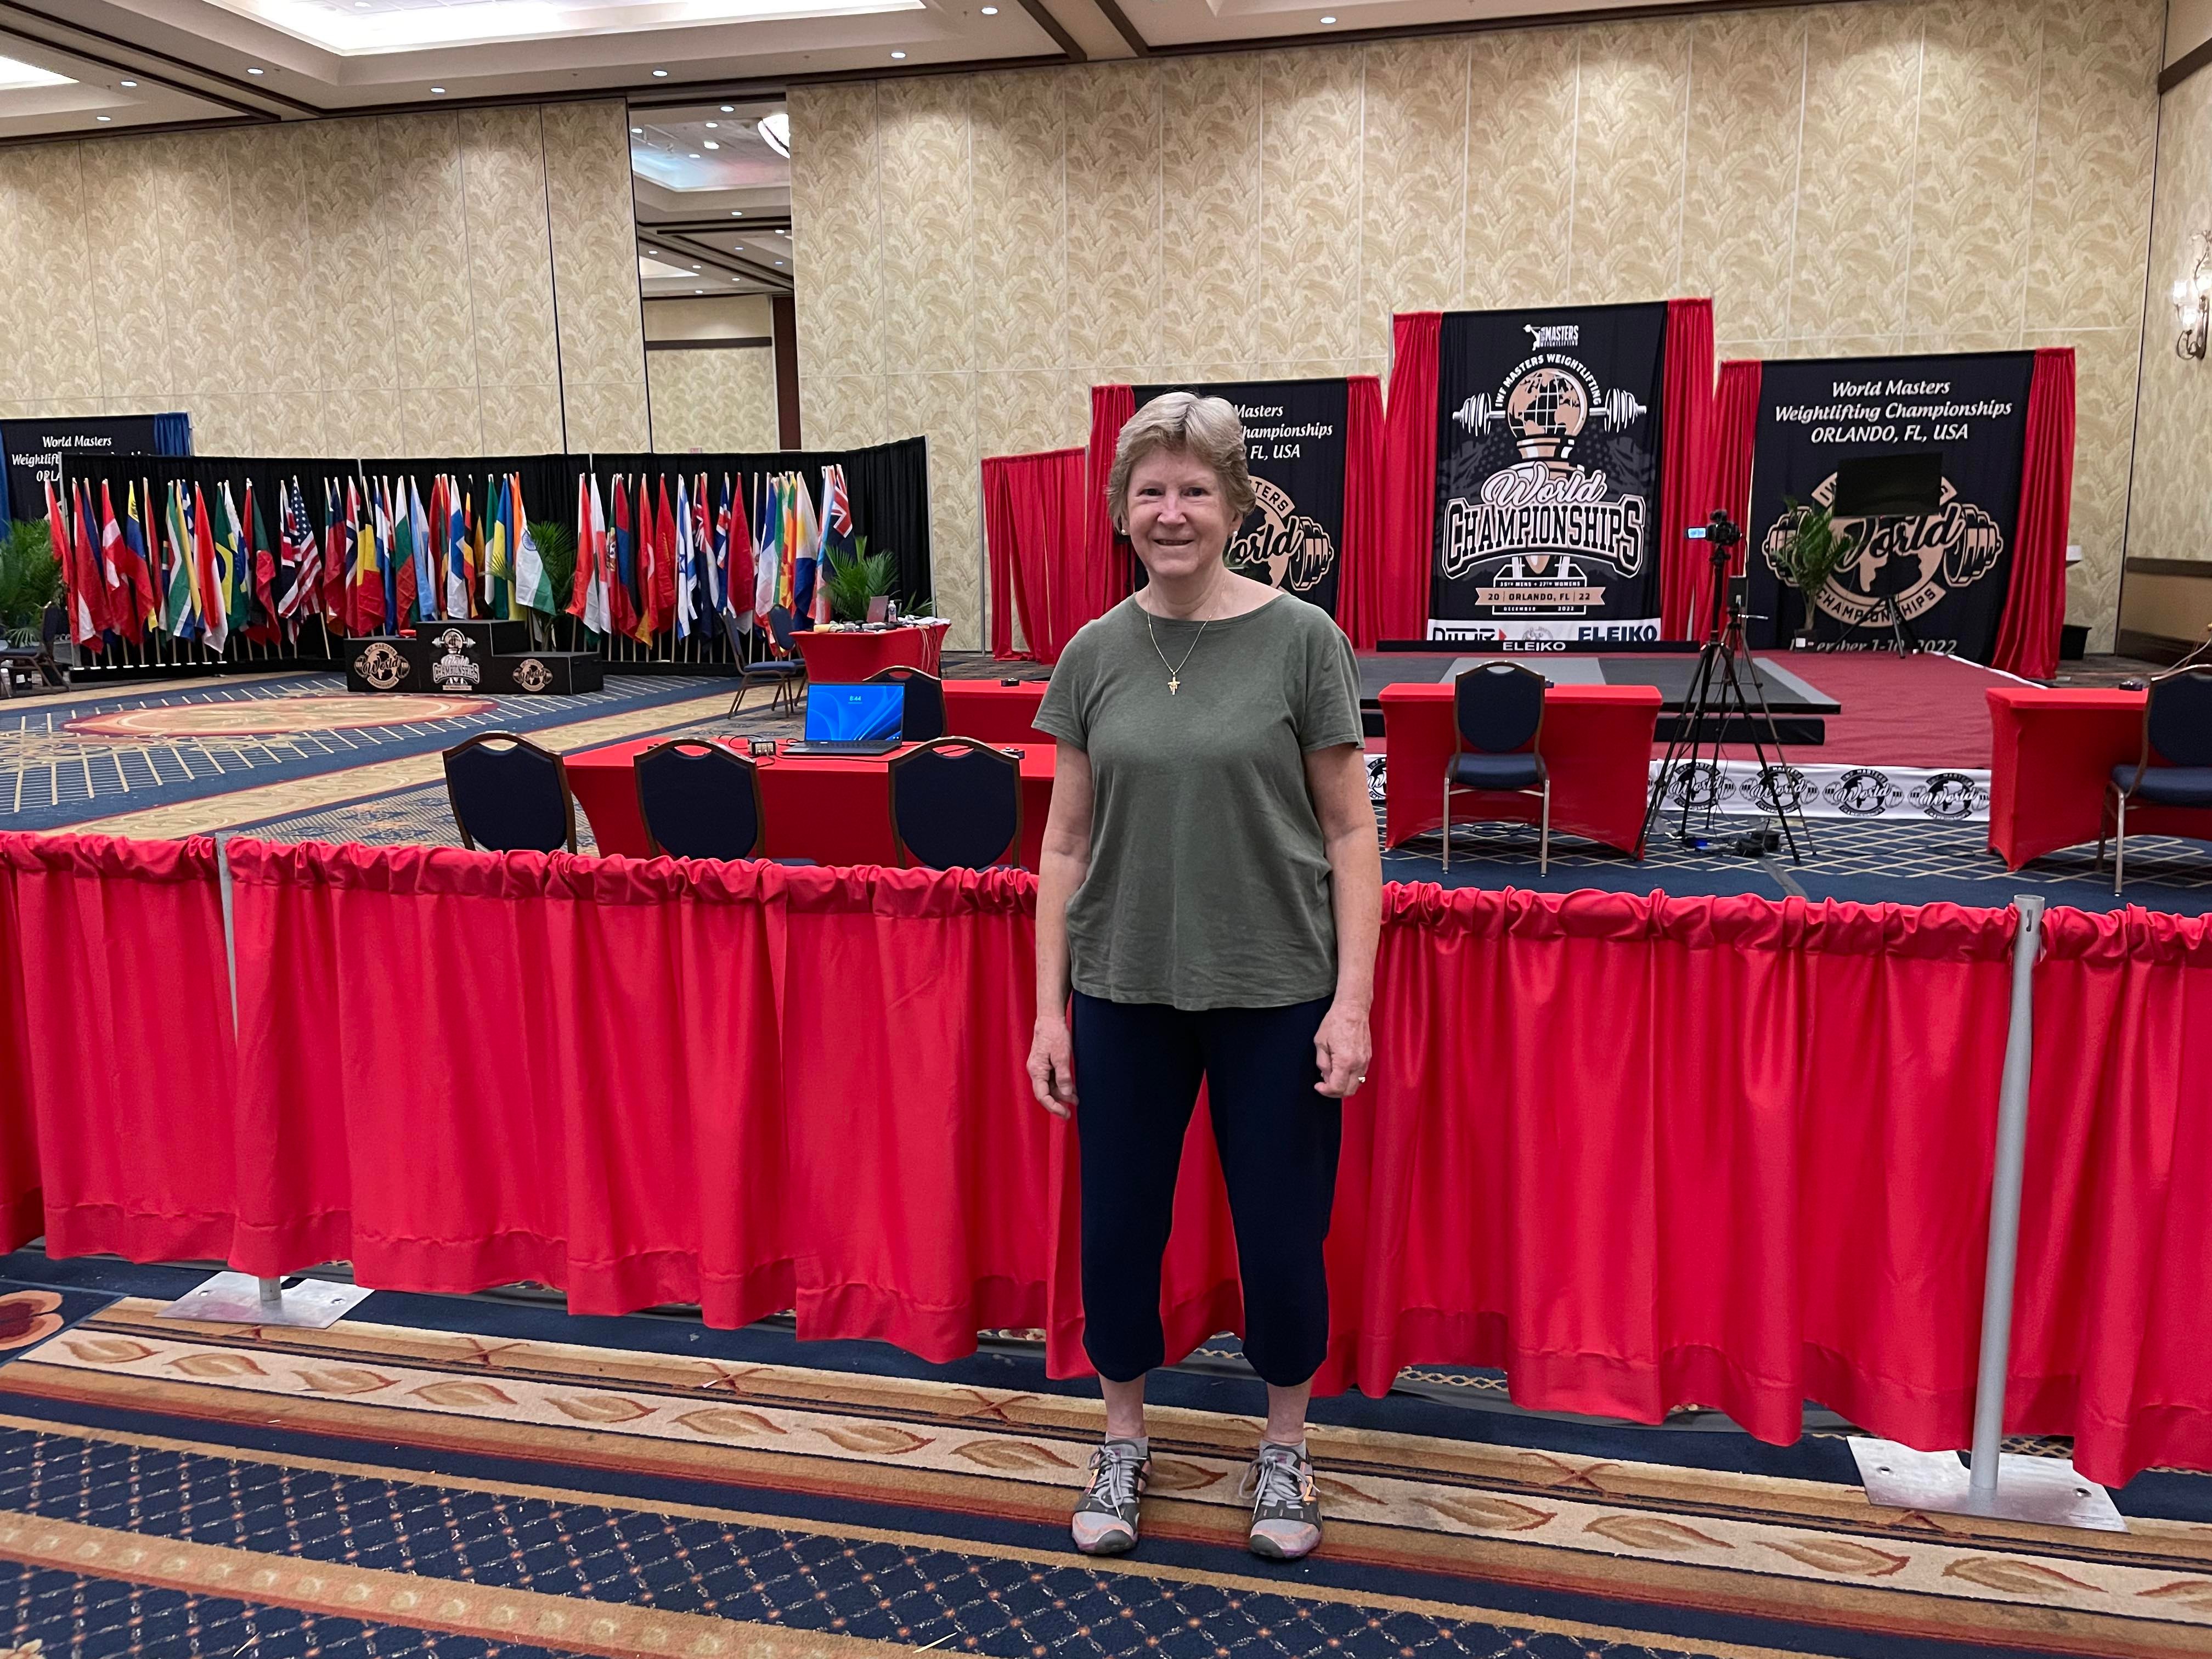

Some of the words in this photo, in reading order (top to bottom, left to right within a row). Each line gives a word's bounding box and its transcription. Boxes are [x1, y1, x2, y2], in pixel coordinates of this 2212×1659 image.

[1545, 325, 1579, 341] MASTERS
[1495, 387, 1507, 408] IWF
[1503, 354, 1544, 388] MASTERS
[1546, 354, 1602, 406] WEIGHTLIFTING
[1832, 381, 1882, 398] World
[1885, 380, 1951, 396] Masters
[1235, 404, 1284, 418] Masters
[1775, 404, 1881, 424] Weightlifting
[1885, 399, 2013, 421] Championships
[1242, 422, 1333, 441] hampionships
[1811, 425, 1898, 444] ORLANDO,
[1904, 425, 1927, 443] FL,
[1933, 424, 1968, 441] USA
[43, 436, 72, 448] World
[74, 435, 112, 447] Masters
[12, 453, 60, 467] Weightlift
[1250, 445, 1268, 461] FL,
[1273, 444, 1300, 459] USA
[1482, 461, 1607, 507] World
[1443, 495, 1645, 574] CHAMPIONSHIPS
[1508, 593, 1556, 601] ORLANDO,
[1578, 592, 1590, 601] 22
[1578, 625, 1658, 641] ELEIKO
[1503, 641, 1566, 651] ELEIKO
[362, 654, 401, 675] World
[1833, 783, 1892, 803] World
[1918, 787, 1979, 807] World
